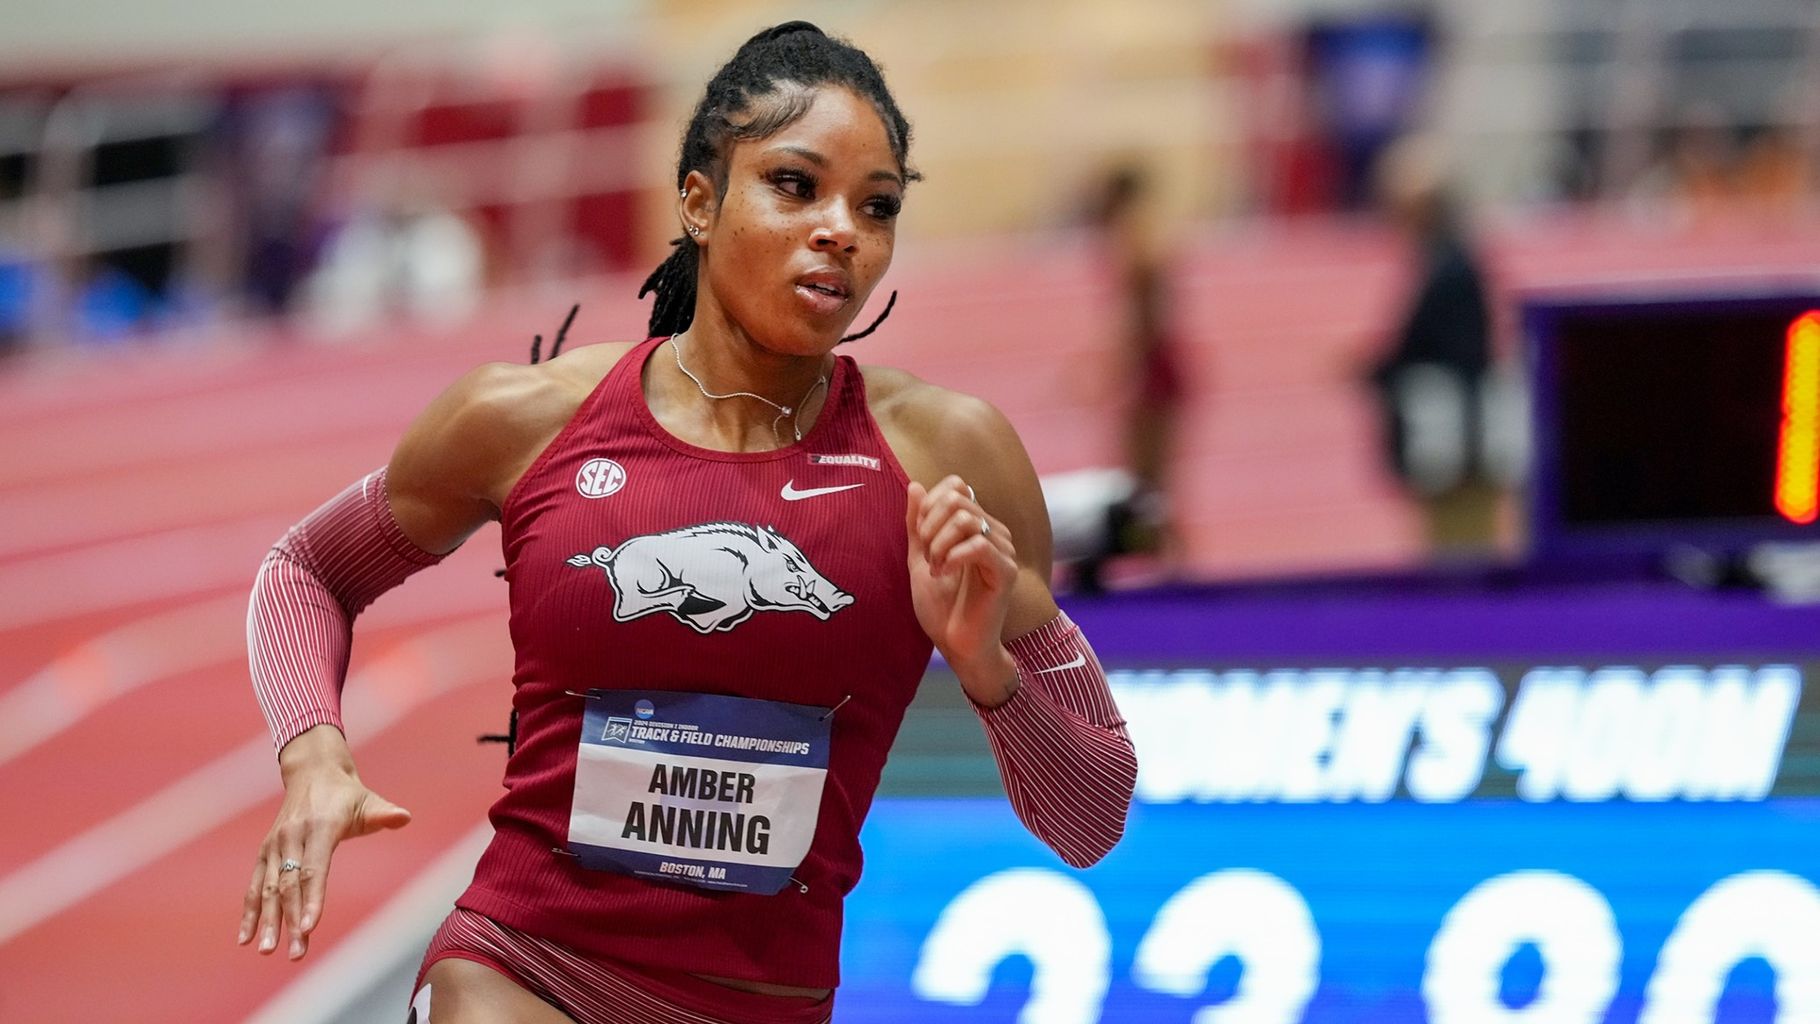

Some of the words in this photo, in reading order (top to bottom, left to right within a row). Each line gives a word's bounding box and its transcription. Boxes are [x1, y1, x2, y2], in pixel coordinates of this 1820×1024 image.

[578, 460, 623, 496] SEC
[818, 454, 878, 469] EQUALITY
[631, 726, 669, 742] TRACK
[669, 730, 680, 742] &
[680, 731, 713, 746] FIELD
[714, 734, 810, 755] CHAMPIONSHIPS
[1108, 668, 1502, 804] OMEN'S
[1496, 664, 1801, 803] 400M
[648, 763, 756, 804] AMBER
[621, 801, 771, 855] ANNING
[659, 861, 705, 879] BOSTON,
[708, 866, 726, 880] MA
